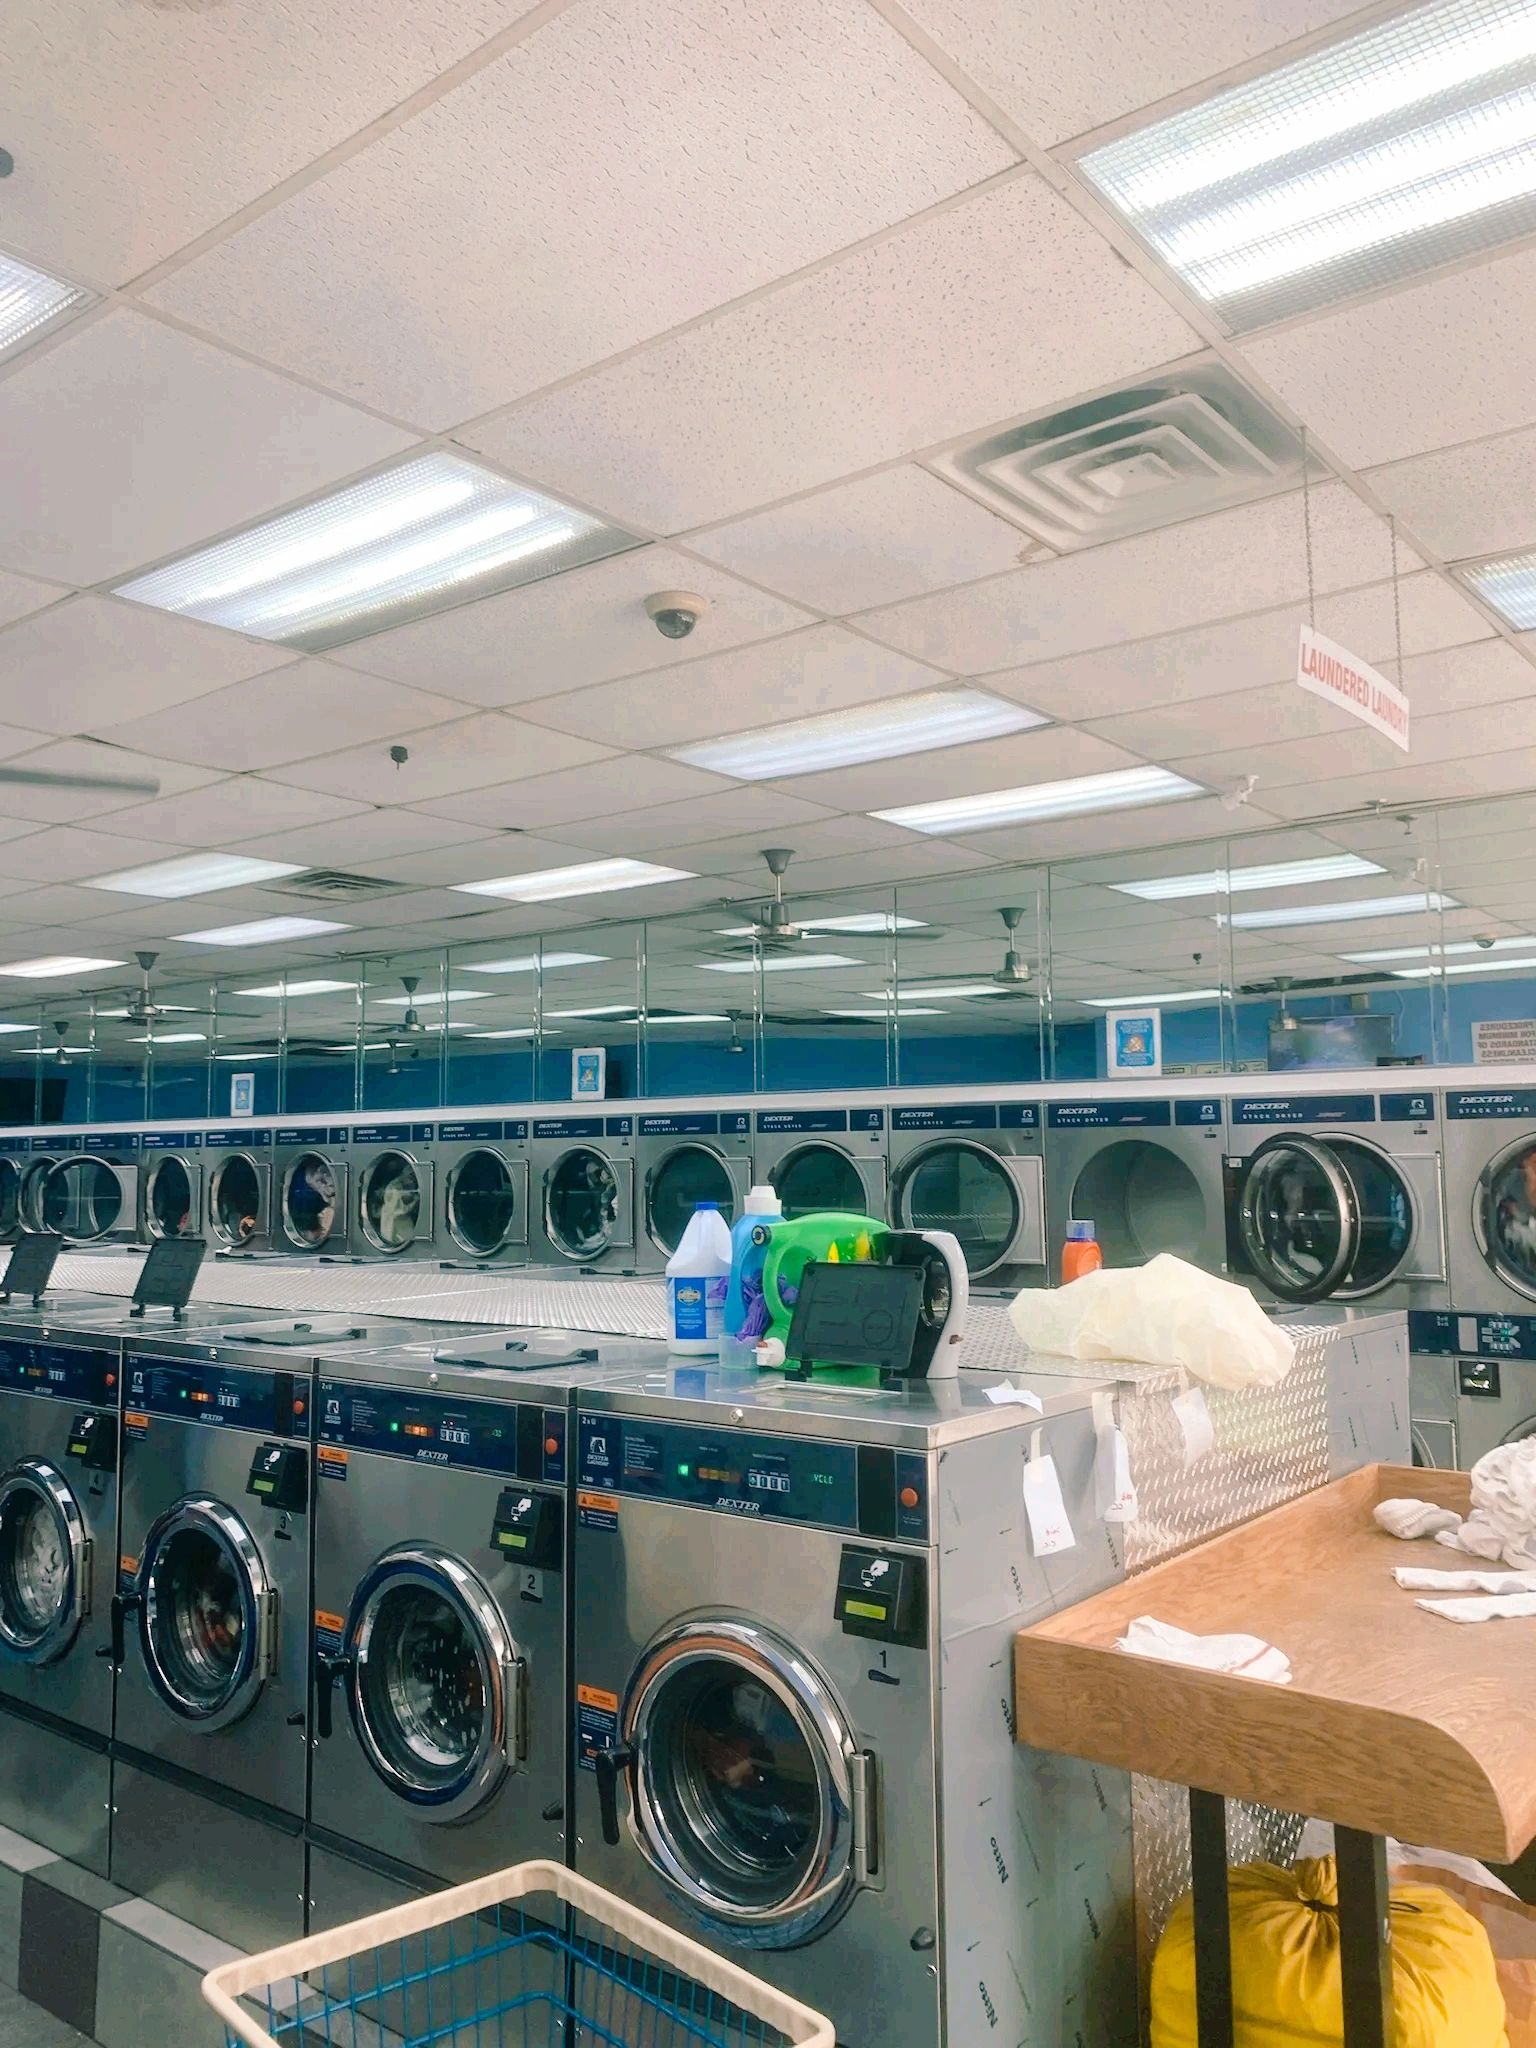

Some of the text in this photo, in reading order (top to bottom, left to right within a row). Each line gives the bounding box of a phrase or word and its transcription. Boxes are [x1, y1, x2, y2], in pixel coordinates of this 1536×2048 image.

[1301, 643, 1370, 708] LAUNDERED
[1242, 1102, 1290, 1111] DEXTER
[1459, 1094, 1514, 1105] DEXTER
[1057, 1107, 1098, 1115] DEXTER
[643, 1118, 671, 1126] DEXTER
[416, 1448, 450, 1462] DEXTER
[716, 1496, 761, 1512] DEXTER
[279, 1515, 286, 1529] 3
[527, 1574, 536, 1590] 2
[879, 1650, 887, 1668] 1
[990, 1836, 1010, 1884] Nitto
[978, 1980, 999, 2029] Nitto
